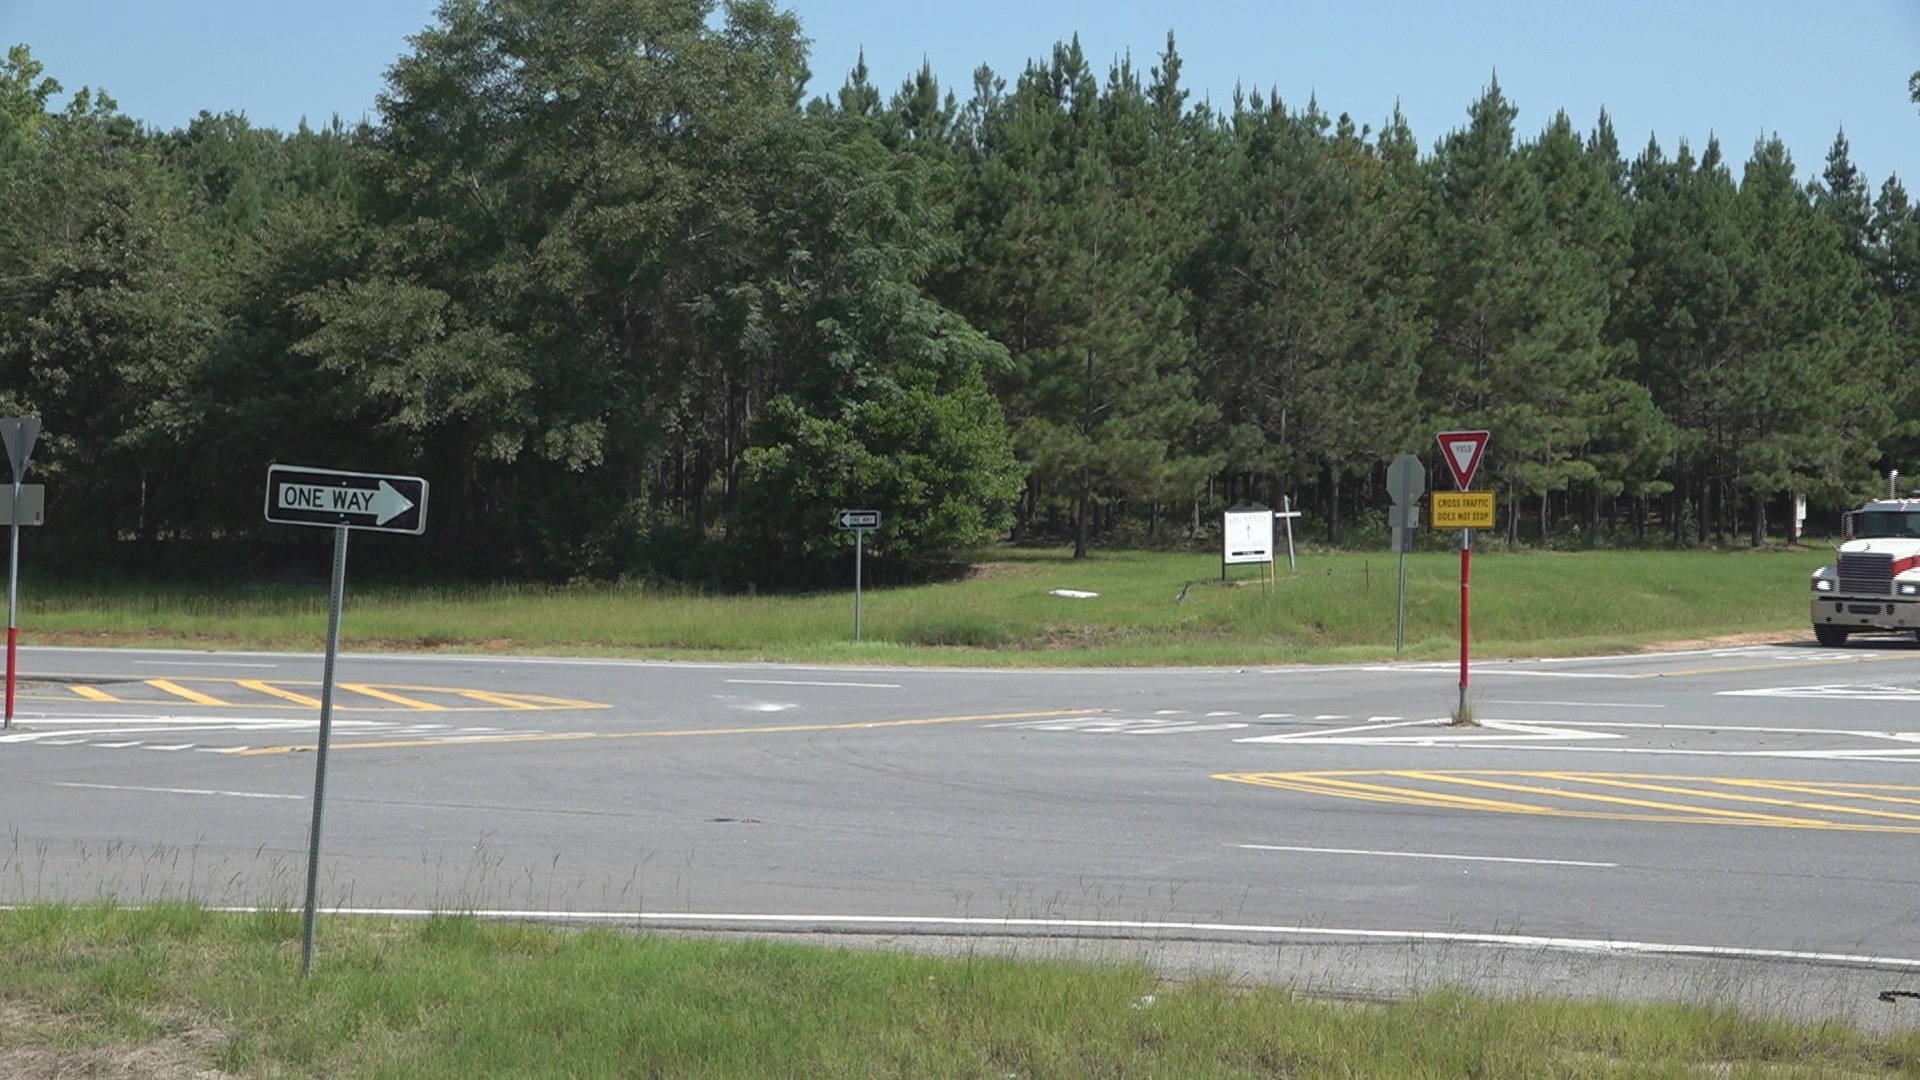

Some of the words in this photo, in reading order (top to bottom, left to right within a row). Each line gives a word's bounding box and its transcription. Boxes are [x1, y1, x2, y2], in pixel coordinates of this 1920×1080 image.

[1456, 445, 1472, 453] YIELD
[284, 486, 324, 508] ONE
[332, 490, 375, 511] WAY
[1437, 498, 1461, 508] CROSS
[1462, 498, 1489, 508] TRAFFIC
[1437, 512, 1456, 521] DOES
[1457, 512, 1470, 521] NOT
[1472, 512, 1489, 521] STOP
